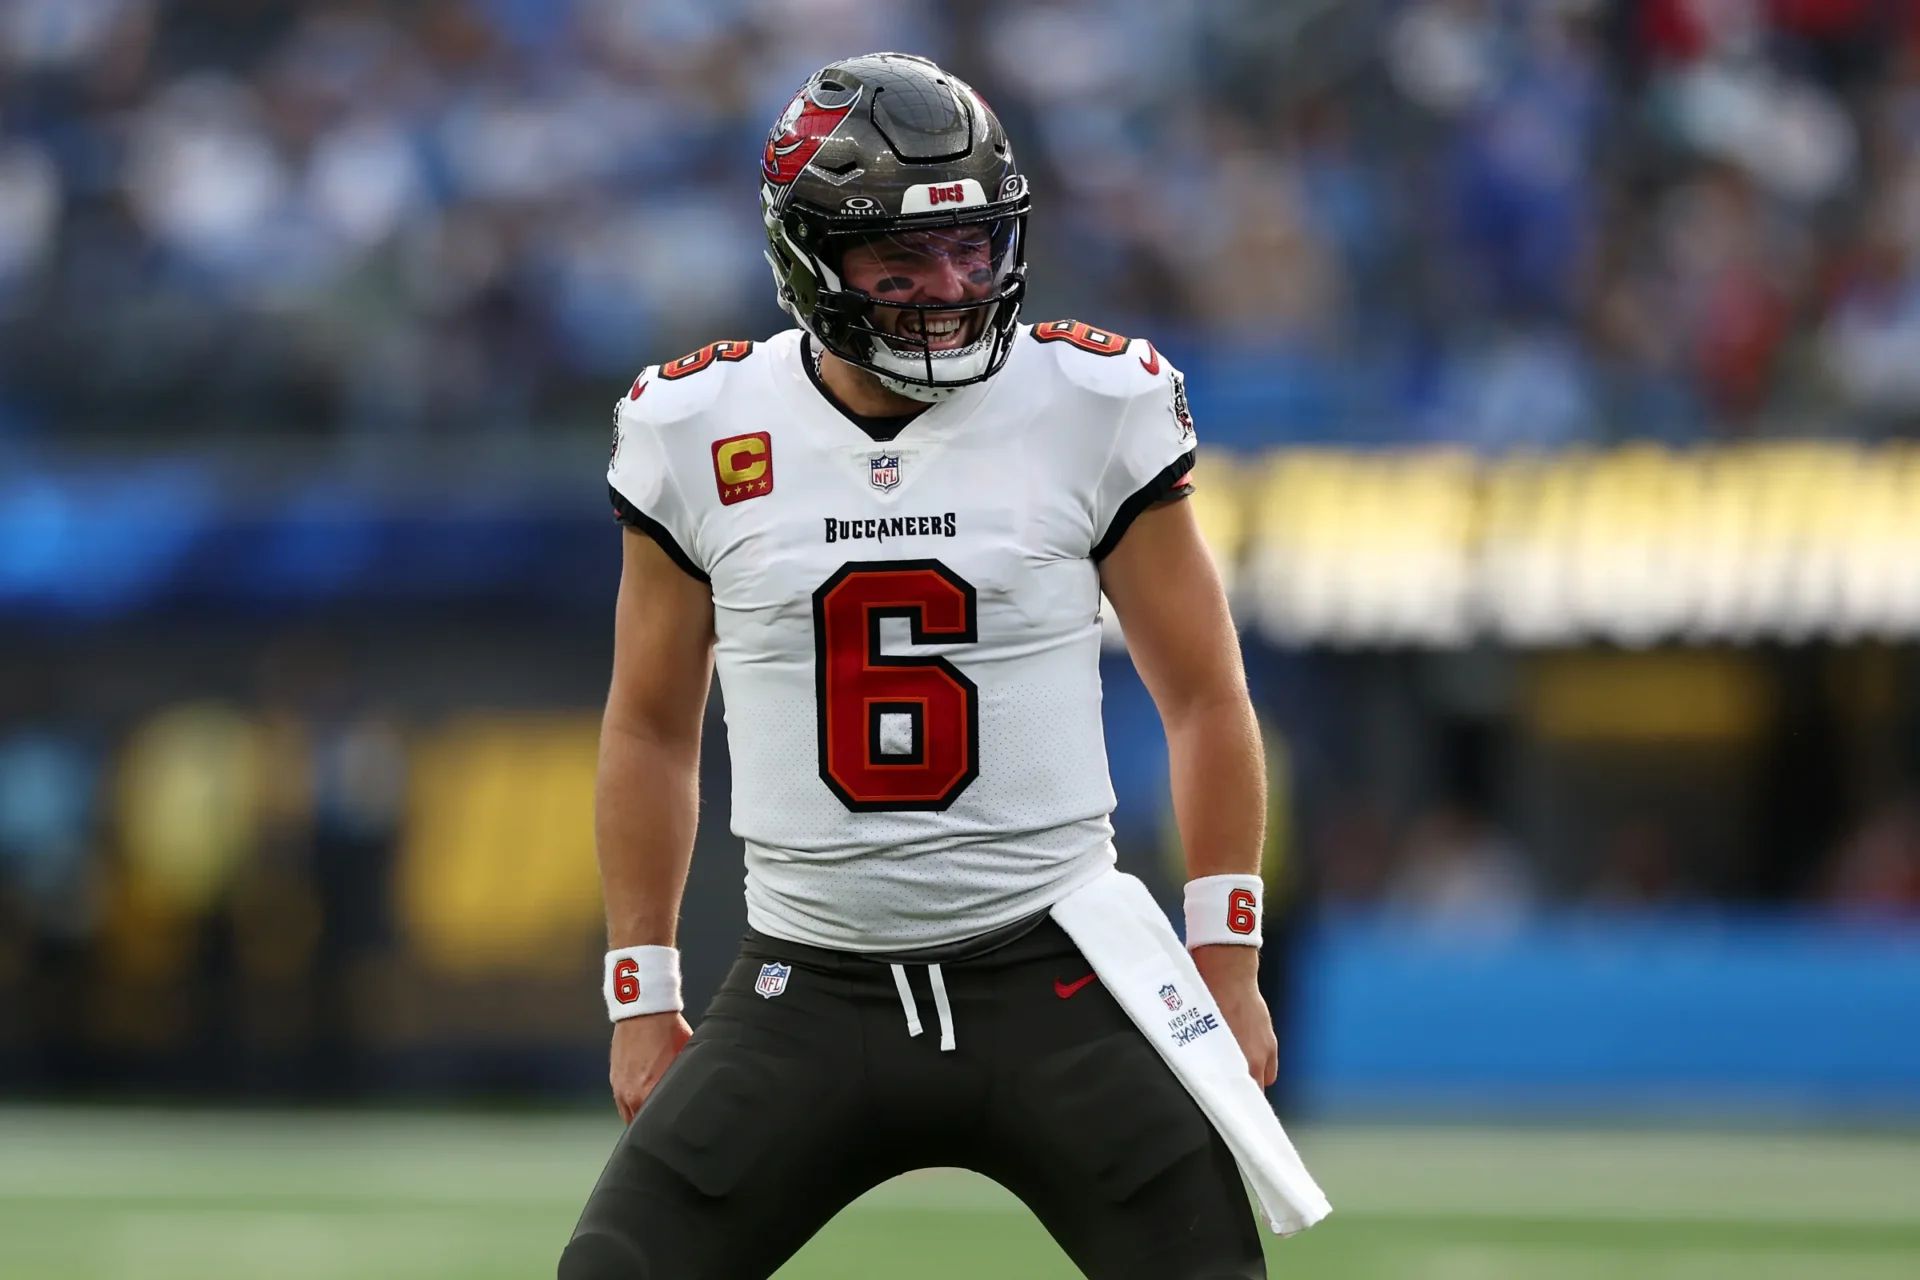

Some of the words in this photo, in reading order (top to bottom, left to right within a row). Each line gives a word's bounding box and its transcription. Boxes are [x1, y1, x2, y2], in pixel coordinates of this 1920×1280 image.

[928, 184, 964, 205] BUCS
[1030, 320, 1131, 357] 6
[658, 340, 753, 380] 6
[717, 437, 767, 485] C
[874, 469, 897, 484] NFL
[824, 513, 956, 543] BUCCANEERS
[812, 558, 979, 812] 6
[1227, 888, 1256, 935] 6
[613, 958, 640, 1004] 6
[760, 977, 781, 991] NFL
[1167, 1007, 1200, 1031] INSPIRE
[1171, 1013, 1219, 1047] CHANGE
